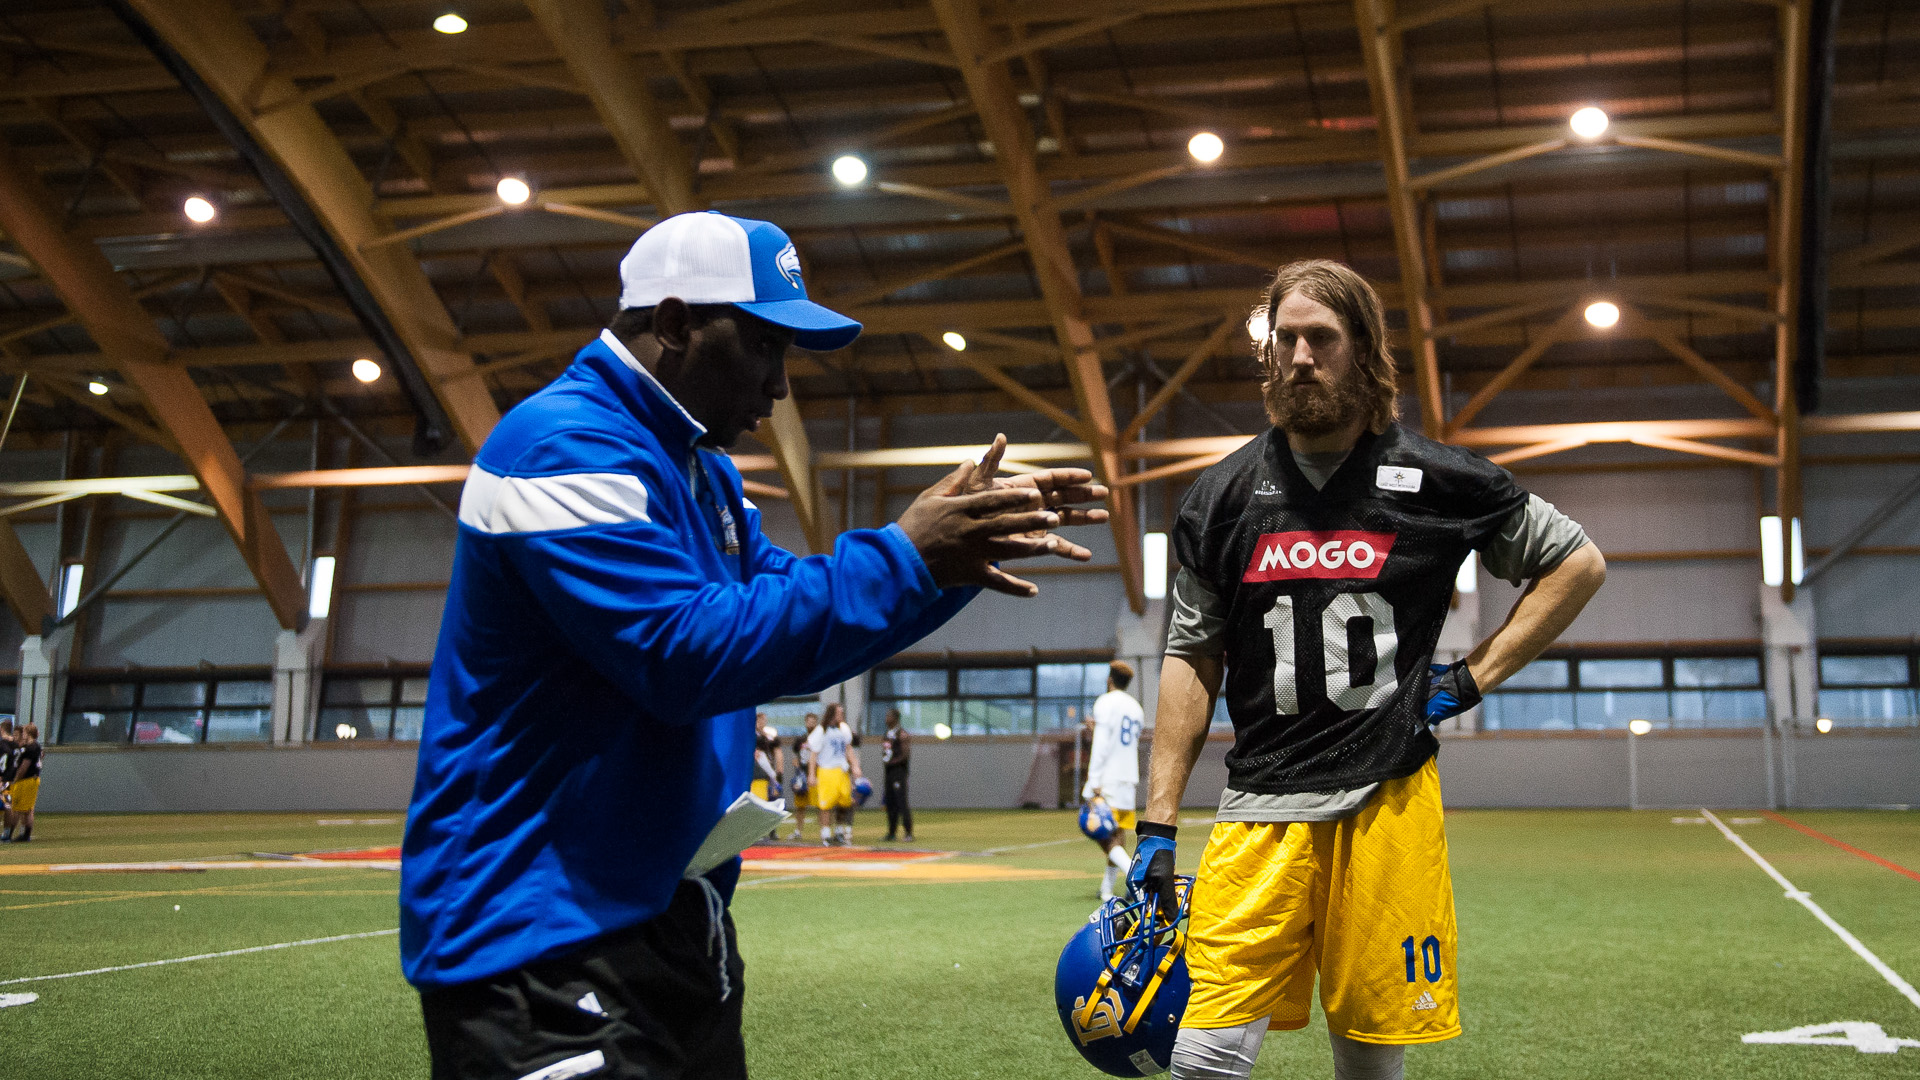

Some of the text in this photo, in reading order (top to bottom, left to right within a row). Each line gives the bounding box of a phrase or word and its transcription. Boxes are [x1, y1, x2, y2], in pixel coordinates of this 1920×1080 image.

[1257, 540, 1376, 572] MOGO
[1263, 591, 1399, 716] 10
[1401, 934, 1443, 984] 10
